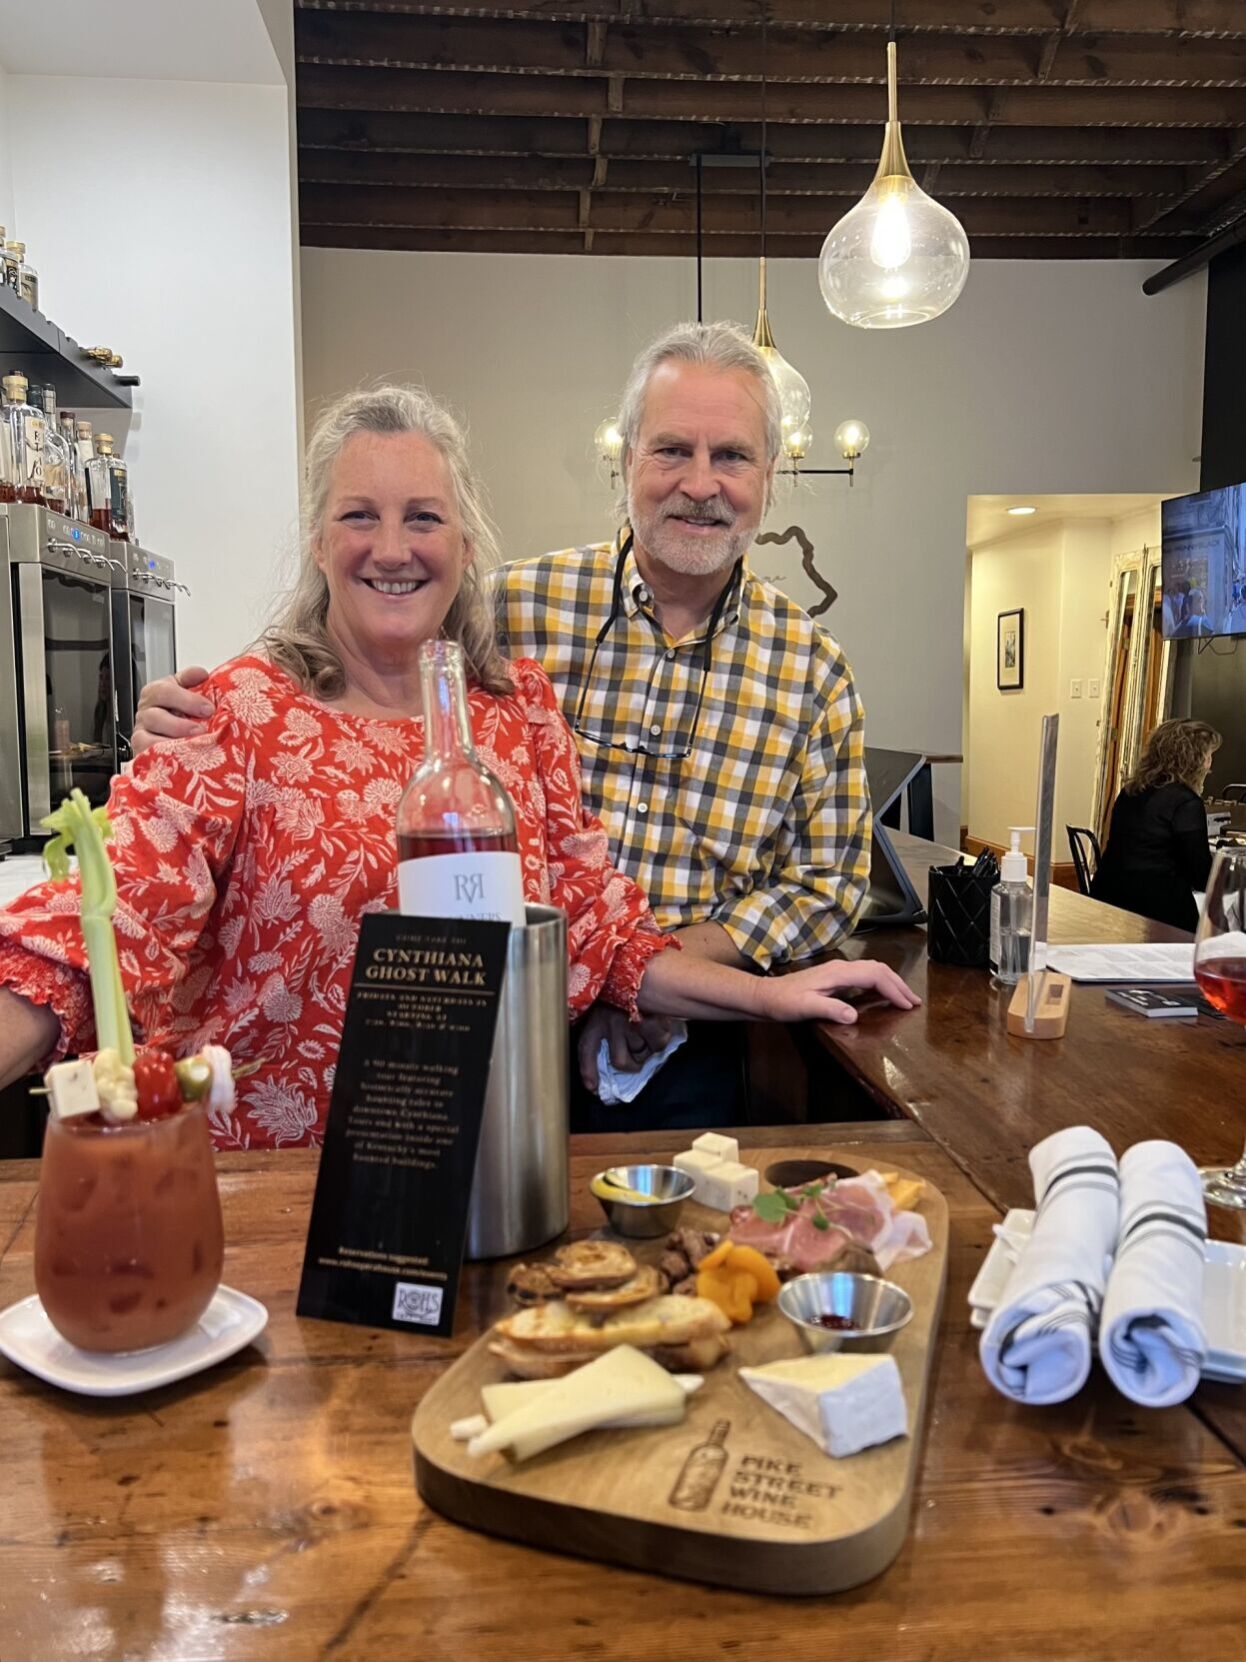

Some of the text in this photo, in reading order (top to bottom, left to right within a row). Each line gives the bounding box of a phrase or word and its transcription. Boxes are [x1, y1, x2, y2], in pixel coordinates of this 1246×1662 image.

[373, 948, 484, 967] CYNTHIANA
[366, 965, 487, 986] GHOST WALK
[398, 1073, 441, 1086] featuring
[423, 1064, 459, 1076] walking
[352, 1105, 397, 1116] downtown
[345, 1128, 402, 1139] presentation
[405, 1133, 433, 1143] inside
[394, 1120, 415, 1129] with
[426, 1125, 460, 1135] special
[352, 1153, 390, 1164] haunted
[338, 1246, 429, 1266] Reservations suggested
[742, 1455, 802, 1475] PIKE
[733, 1471, 843, 1499] STREET
[729, 1486, 797, 1508] WINE
[721, 1501, 814, 1529] HOUSE
